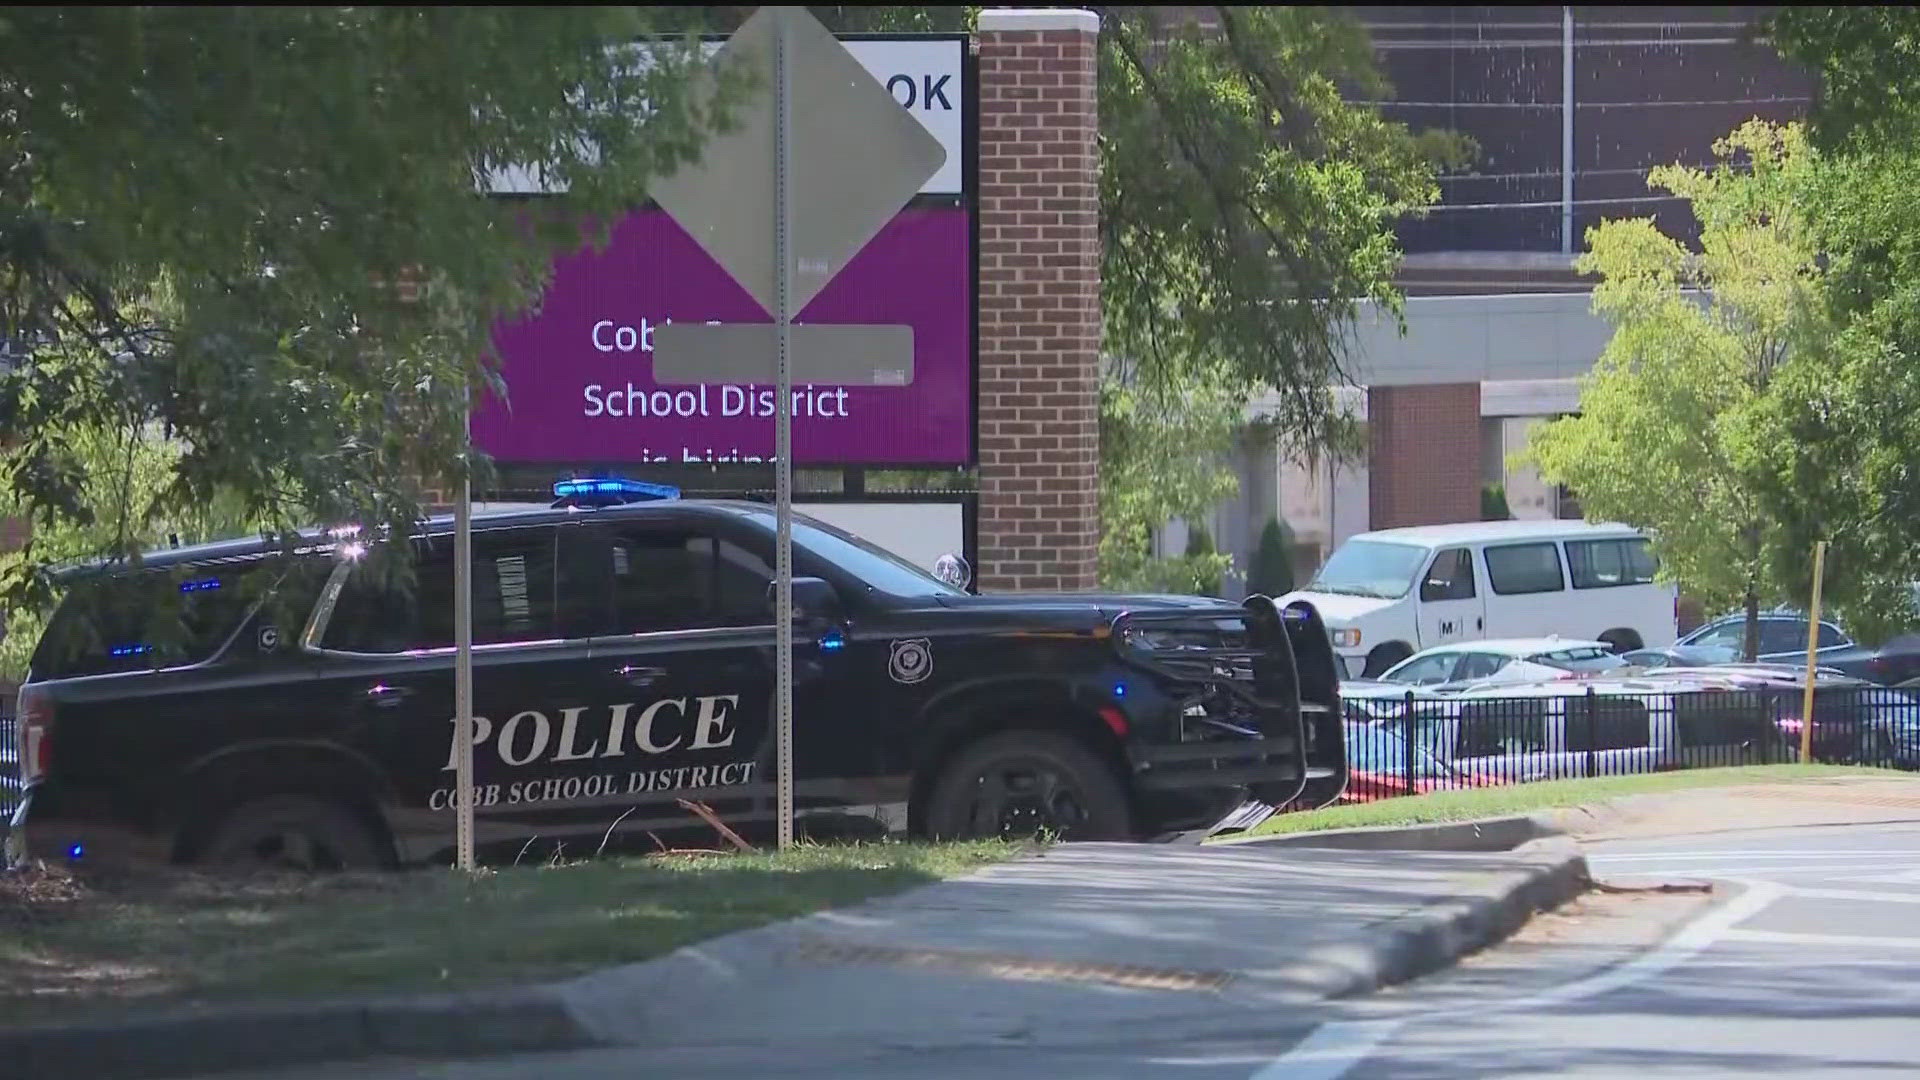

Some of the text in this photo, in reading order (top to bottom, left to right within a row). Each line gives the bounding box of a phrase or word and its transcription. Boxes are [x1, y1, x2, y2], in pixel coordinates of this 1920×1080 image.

[584, 382, 849, 417] School Disrict
[441, 694, 740, 772] POLICE
[507, 774, 618, 805] SCHOOL
[626, 760, 757, 795] DISTRICT
